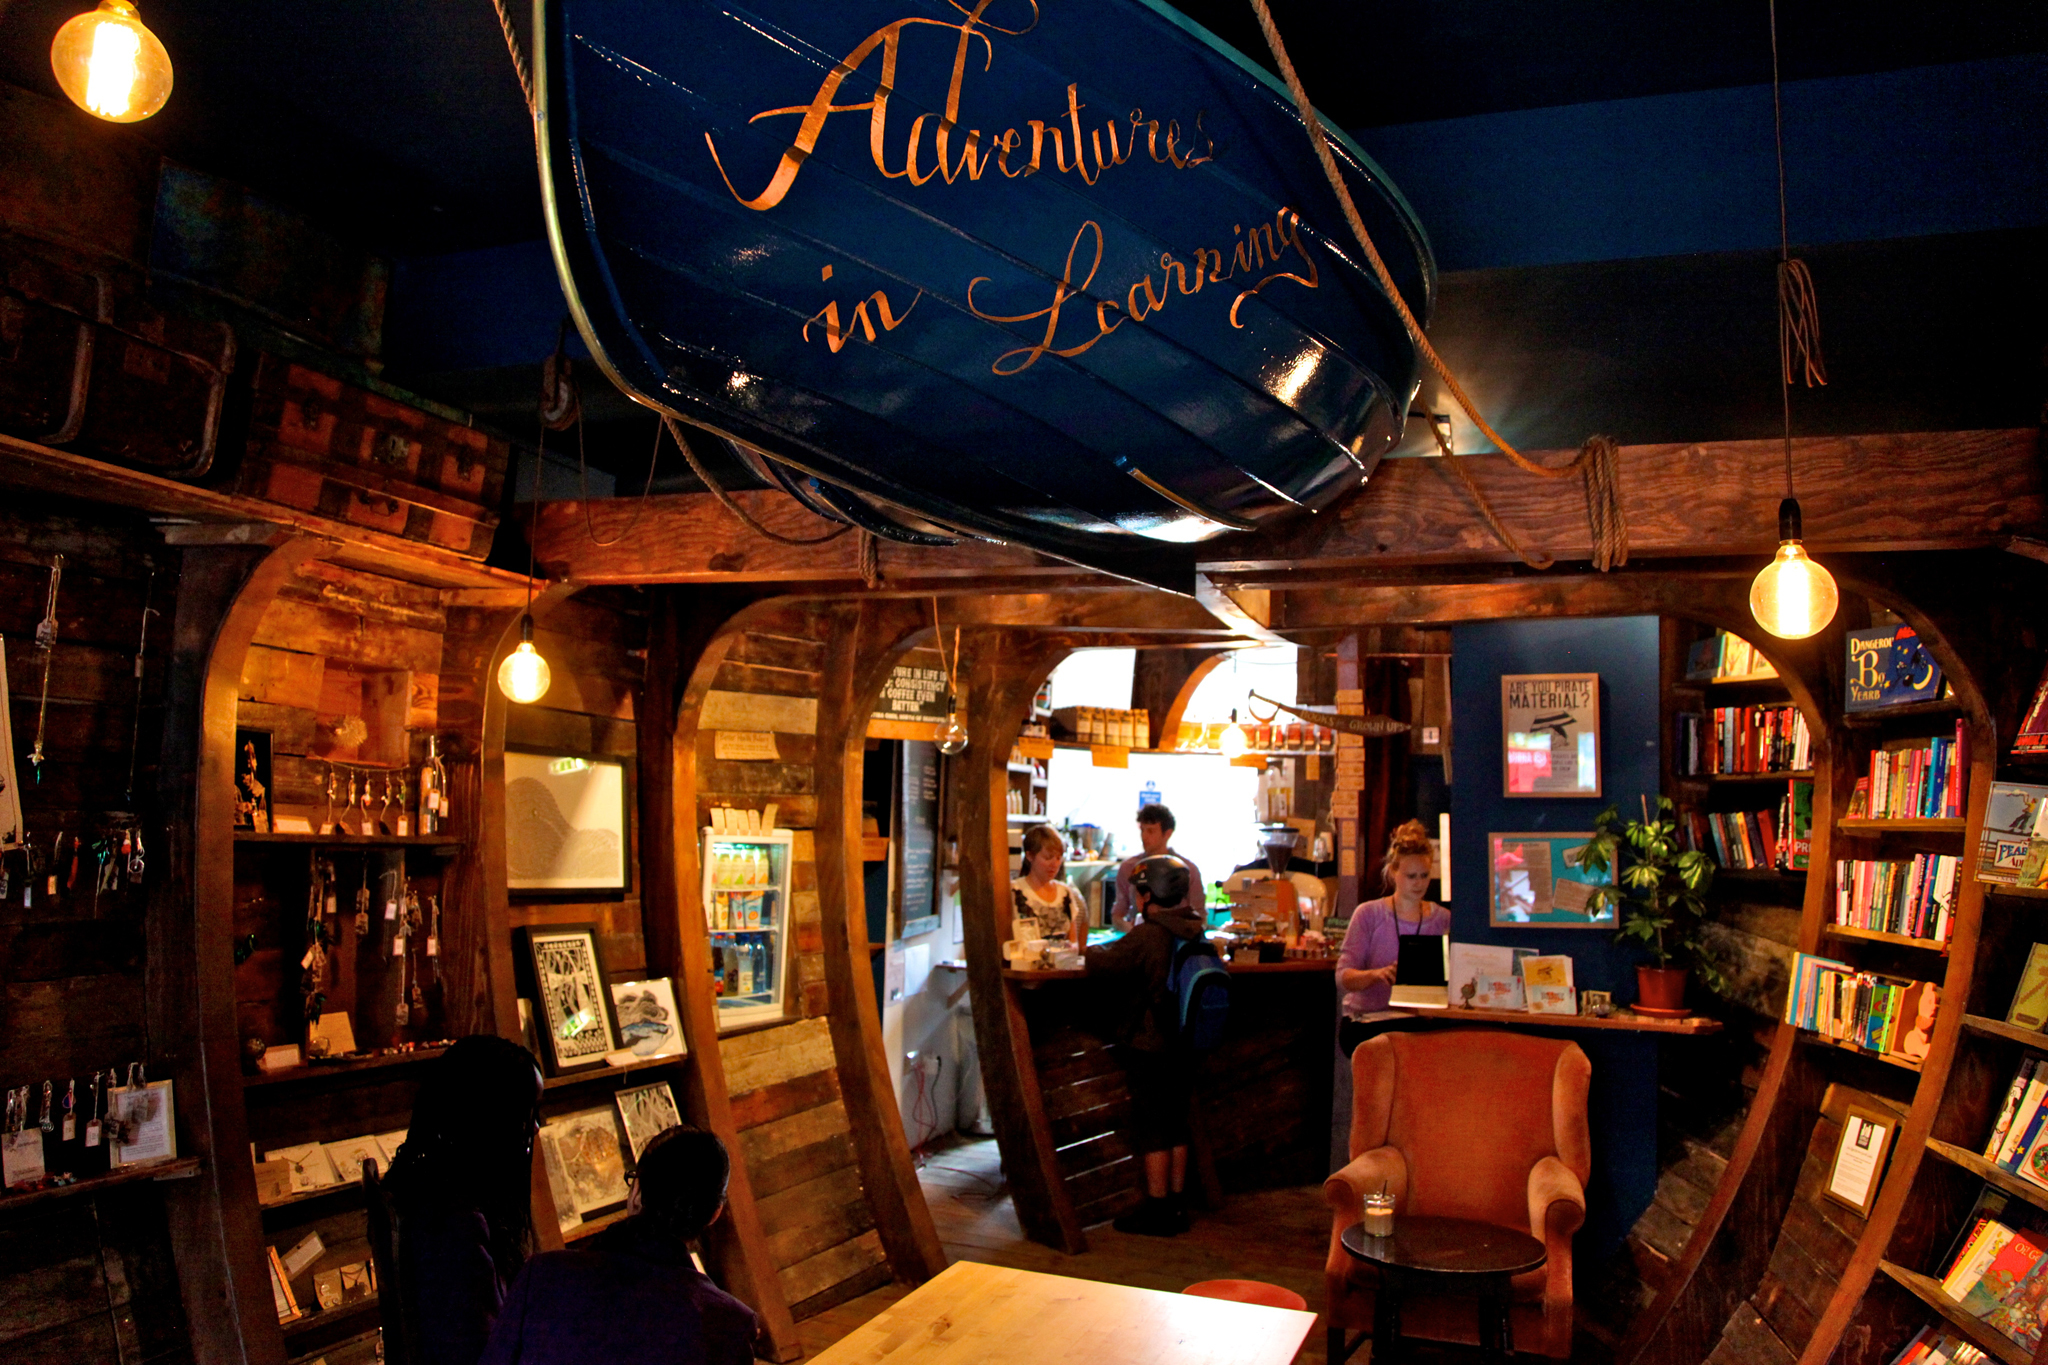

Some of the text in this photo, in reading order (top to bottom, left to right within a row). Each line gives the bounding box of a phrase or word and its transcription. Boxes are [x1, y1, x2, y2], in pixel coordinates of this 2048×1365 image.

[705, 0, 1213, 211] Adventures
[803, 206, 1318, 376] in Learning
[1850, 636, 1895, 655] DANGEROU
[913, 667, 922, 679] IN
[923, 669, 938, 680] LIFE
[895, 677, 946, 692] CONSISTENCY
[1509, 680, 1590, 693] ARE YOU PIRATE
[887, 687, 915, 700] COFFEE
[916, 690, 936, 703] EVEN
[1509, 692, 1590, 709] MATERIAL?
[1850, 686, 1881, 701] YEARB
[1349, 719, 1384, 732] GROWN
[1386, 721, 1404, 732] UPS
[2028, 1248, 2041, 1263] Ge
